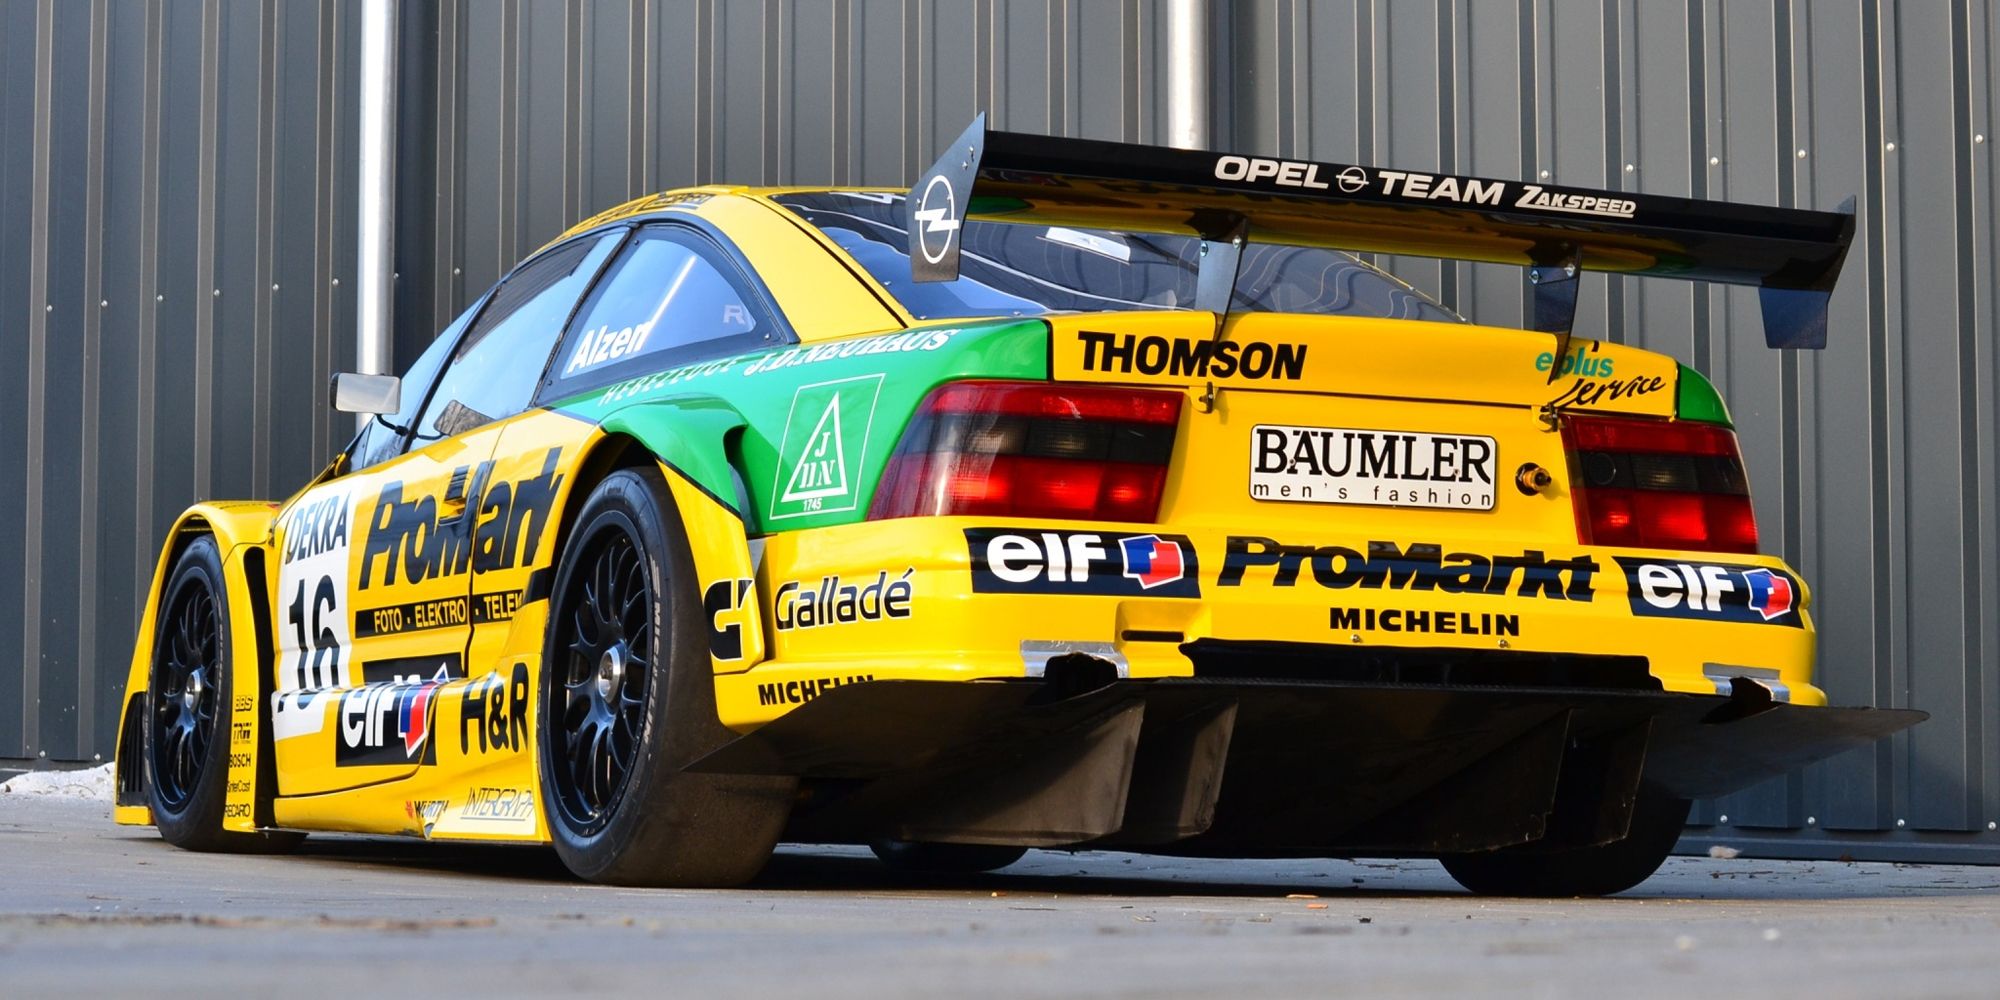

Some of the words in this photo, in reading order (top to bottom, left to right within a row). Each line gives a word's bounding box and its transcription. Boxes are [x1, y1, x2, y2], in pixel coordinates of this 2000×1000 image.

[1214, 155, 1329, 190] OPEL
[1378, 170, 1506, 206] TEAM
[567, 320, 651, 374] Alzen
[1078, 330, 1307, 380] THOMSON
[1254, 428, 1491, 485] BÄUMLER
[803, 497, 822, 512] 1745
[1253, 482, 1348, 499] men's
[1374, 486, 1491, 506] fashion
[285, 490, 351, 566] DEKRA
[987, 533, 1107, 583] elf
[1217, 535, 1601, 602] ProMarkt
[775, 567, 914, 631] Galladé
[1638, 564, 1735, 612] elf
[373, 607, 402, 633] FOTO
[414, 598, 466, 628] ELEKTRO
[1330, 606, 1520, 637] MICHELIN
[278, 574, 341, 710] 16
[342, 674, 421, 748] elf
[460, 662, 529, 756] H&R
[758, 675, 874, 706] MICHE
